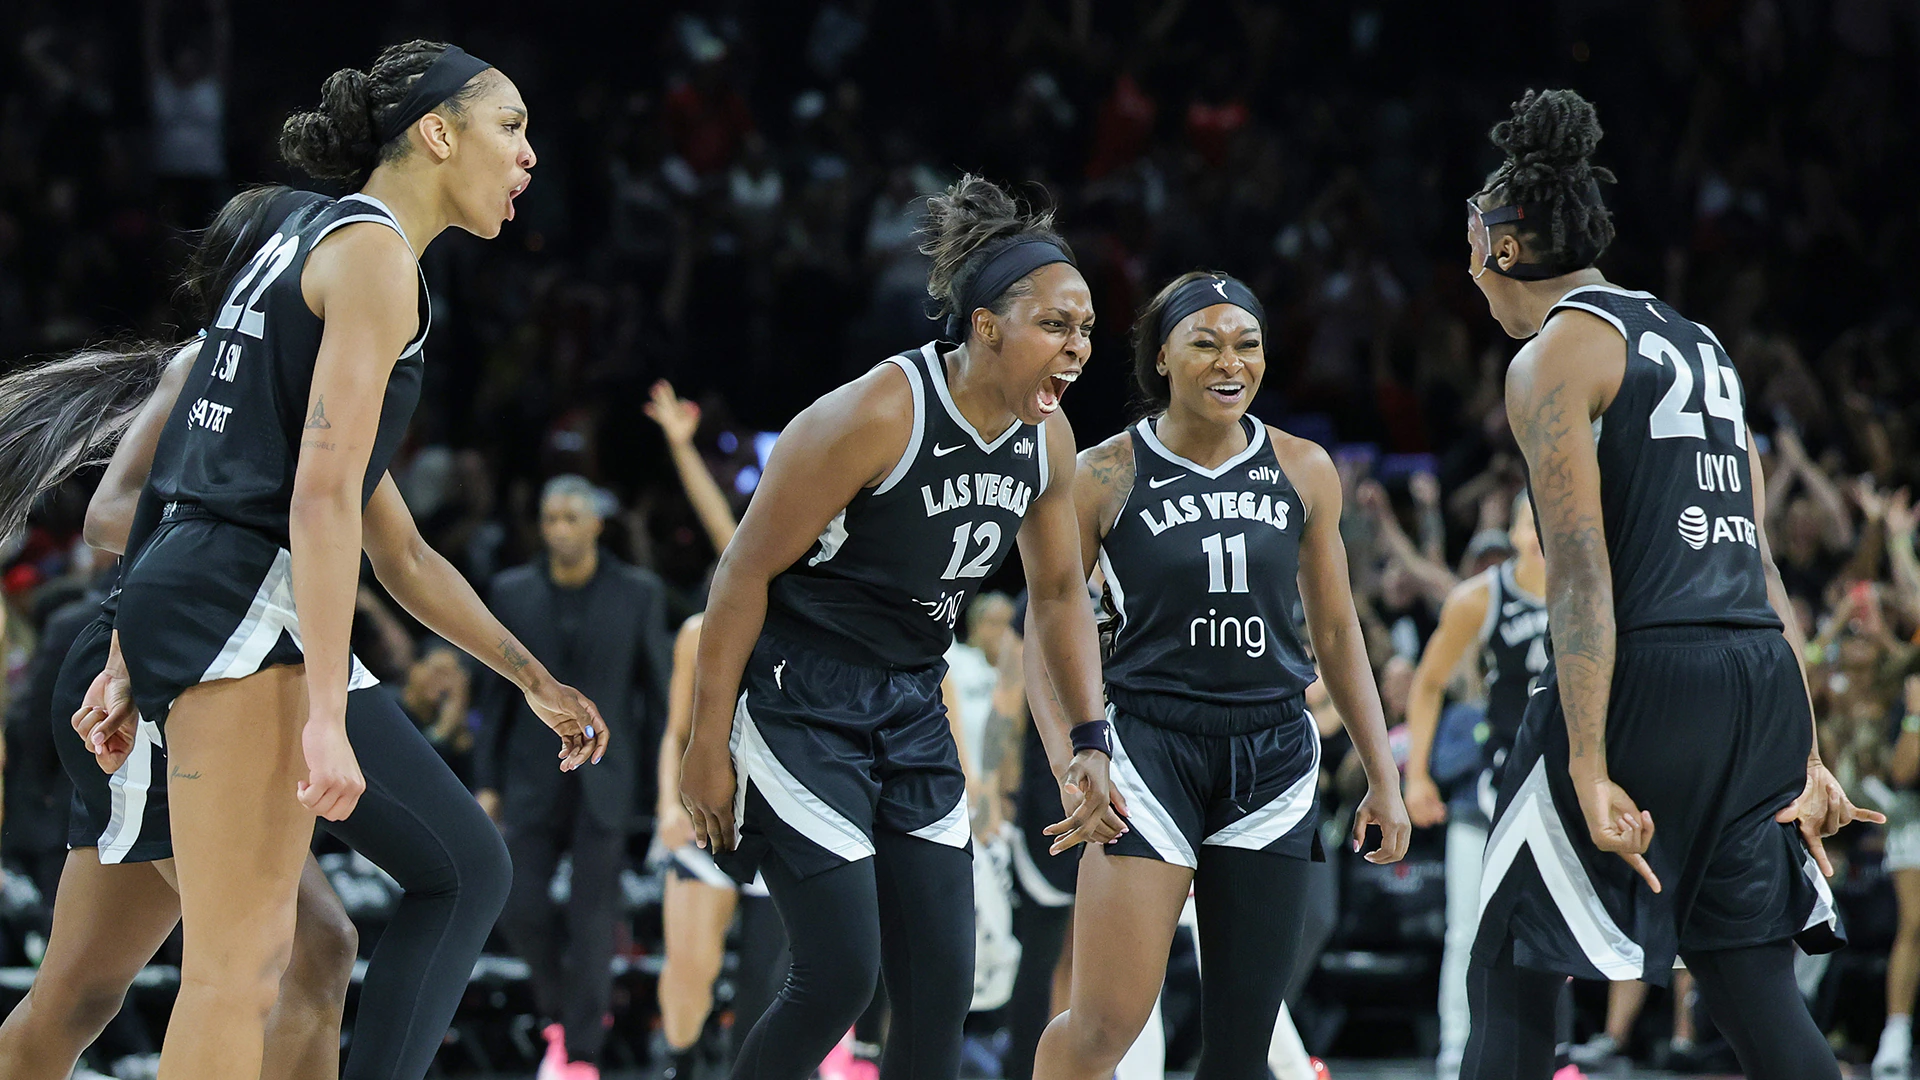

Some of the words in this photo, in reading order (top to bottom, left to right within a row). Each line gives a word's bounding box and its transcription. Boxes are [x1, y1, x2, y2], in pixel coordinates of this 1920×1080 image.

[216, 233, 299, 339] 22
[1638, 331, 1748, 451] 24
[1013, 437, 1034, 459] ally
[1248, 466, 1280, 485] ally
[1696, 451, 1741, 493] LOYD
[920, 474, 972, 517] LAS
[974, 473, 1032, 518] VEGAS
[1139, 495, 1201, 537] LAS
[1201, 491, 1290, 530] VEGAS
[940, 521, 1001, 580] 12
[1712, 516, 1757, 549] AT&T
[1201, 532, 1250, 593] 11
[1190, 608, 1267, 658] ring
